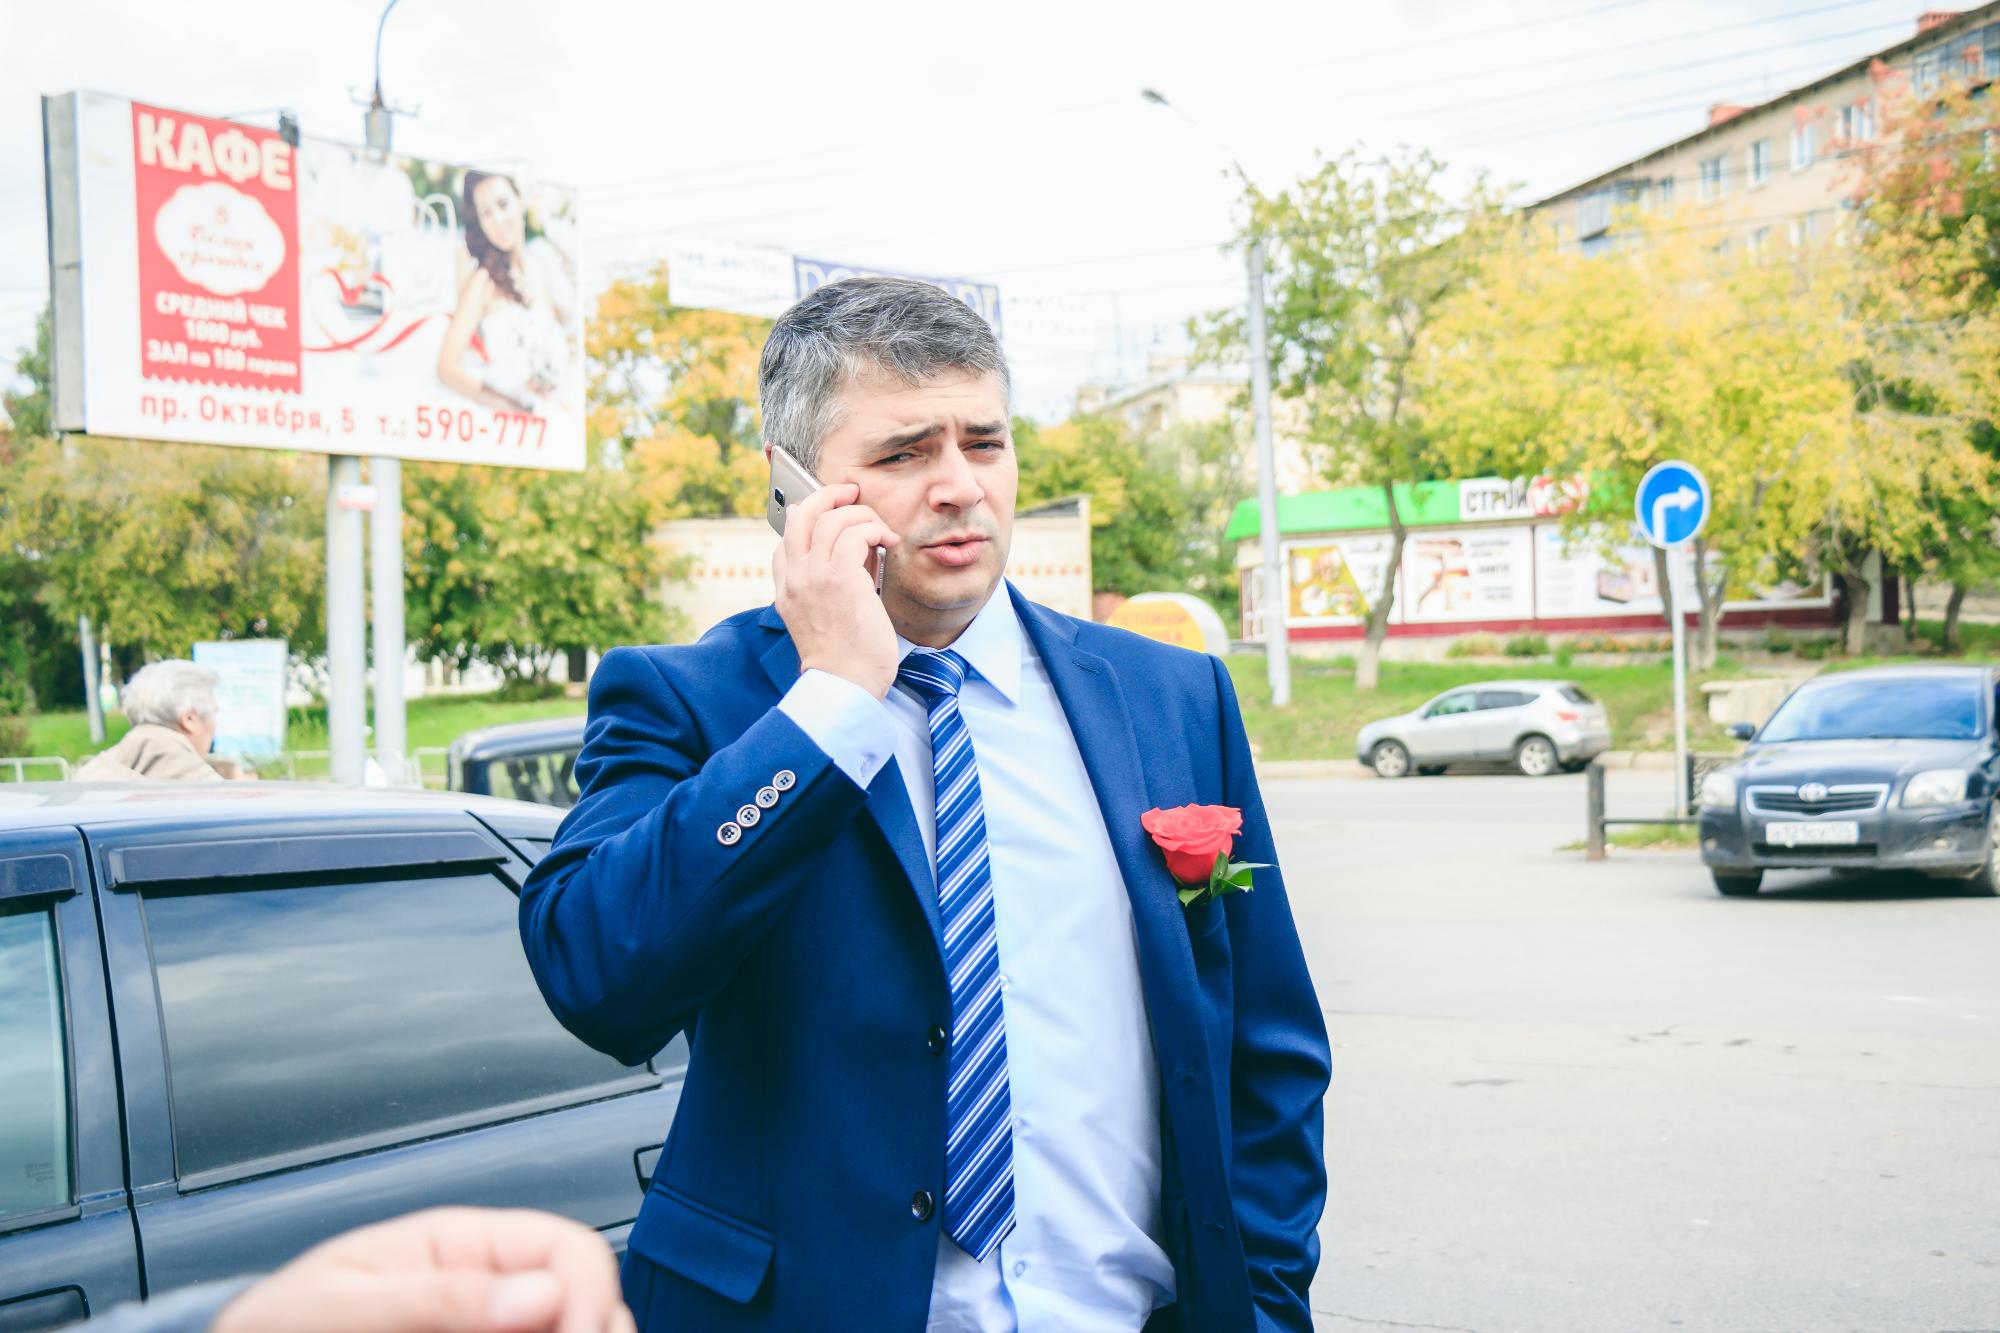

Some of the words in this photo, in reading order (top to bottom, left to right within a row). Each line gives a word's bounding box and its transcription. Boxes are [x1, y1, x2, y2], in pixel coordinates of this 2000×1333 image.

[138, 112, 293, 191] КАФЕ
[146, 339, 188, 365] ЗАЛ
[141, 395, 188, 425] пр.
[199, 394, 331, 434] Октября,
[341, 407, 354, 433] 5
[416, 405, 547, 447] 590-777
